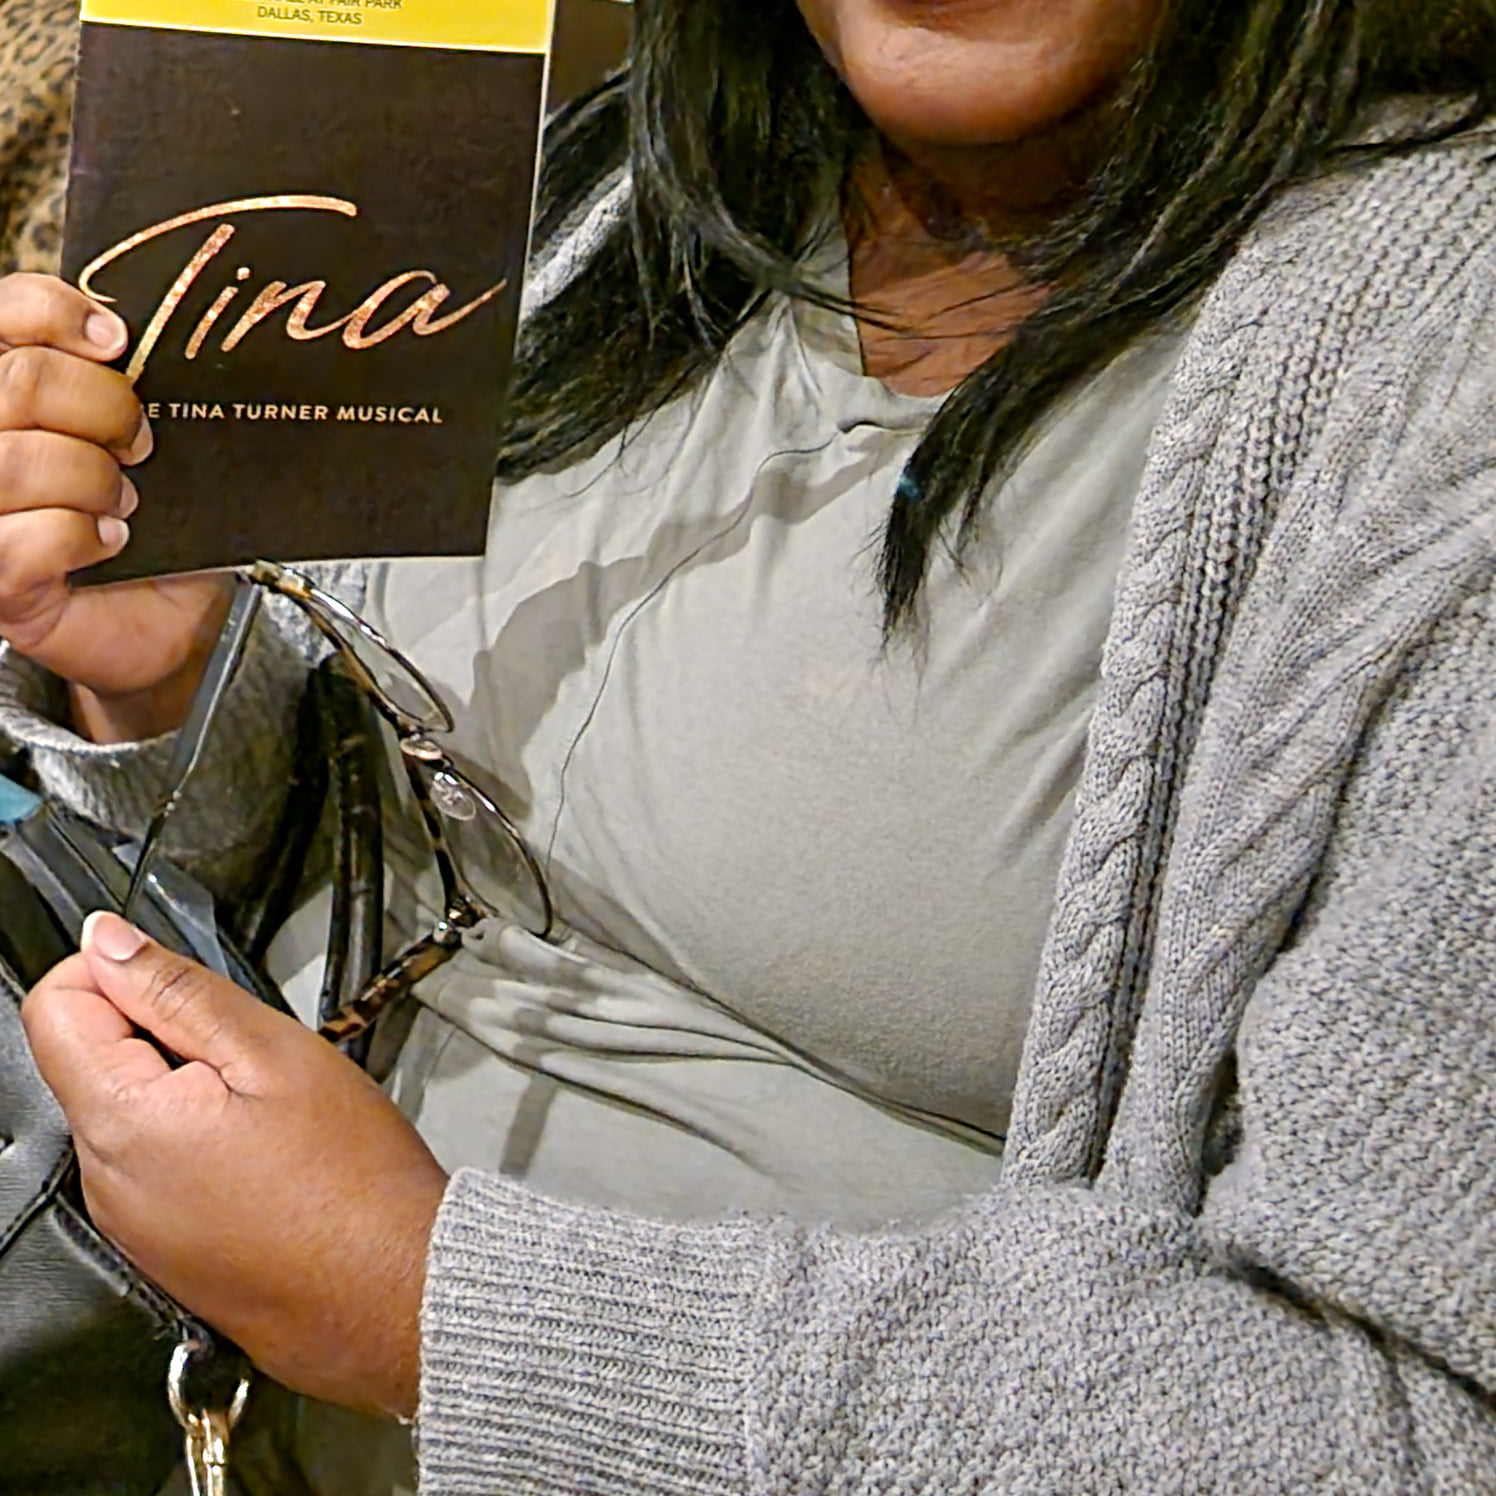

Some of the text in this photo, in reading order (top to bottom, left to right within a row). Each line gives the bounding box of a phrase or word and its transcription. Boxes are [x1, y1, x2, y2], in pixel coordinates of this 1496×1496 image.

[257, 6, 363, 25] DALLAS, TEXAS
[78, 194, 507, 384] Tina
[169, 402, 226, 420] TINA
[232, 403, 328, 421] TURNER
[336, 404, 443, 424] MUSICAL
